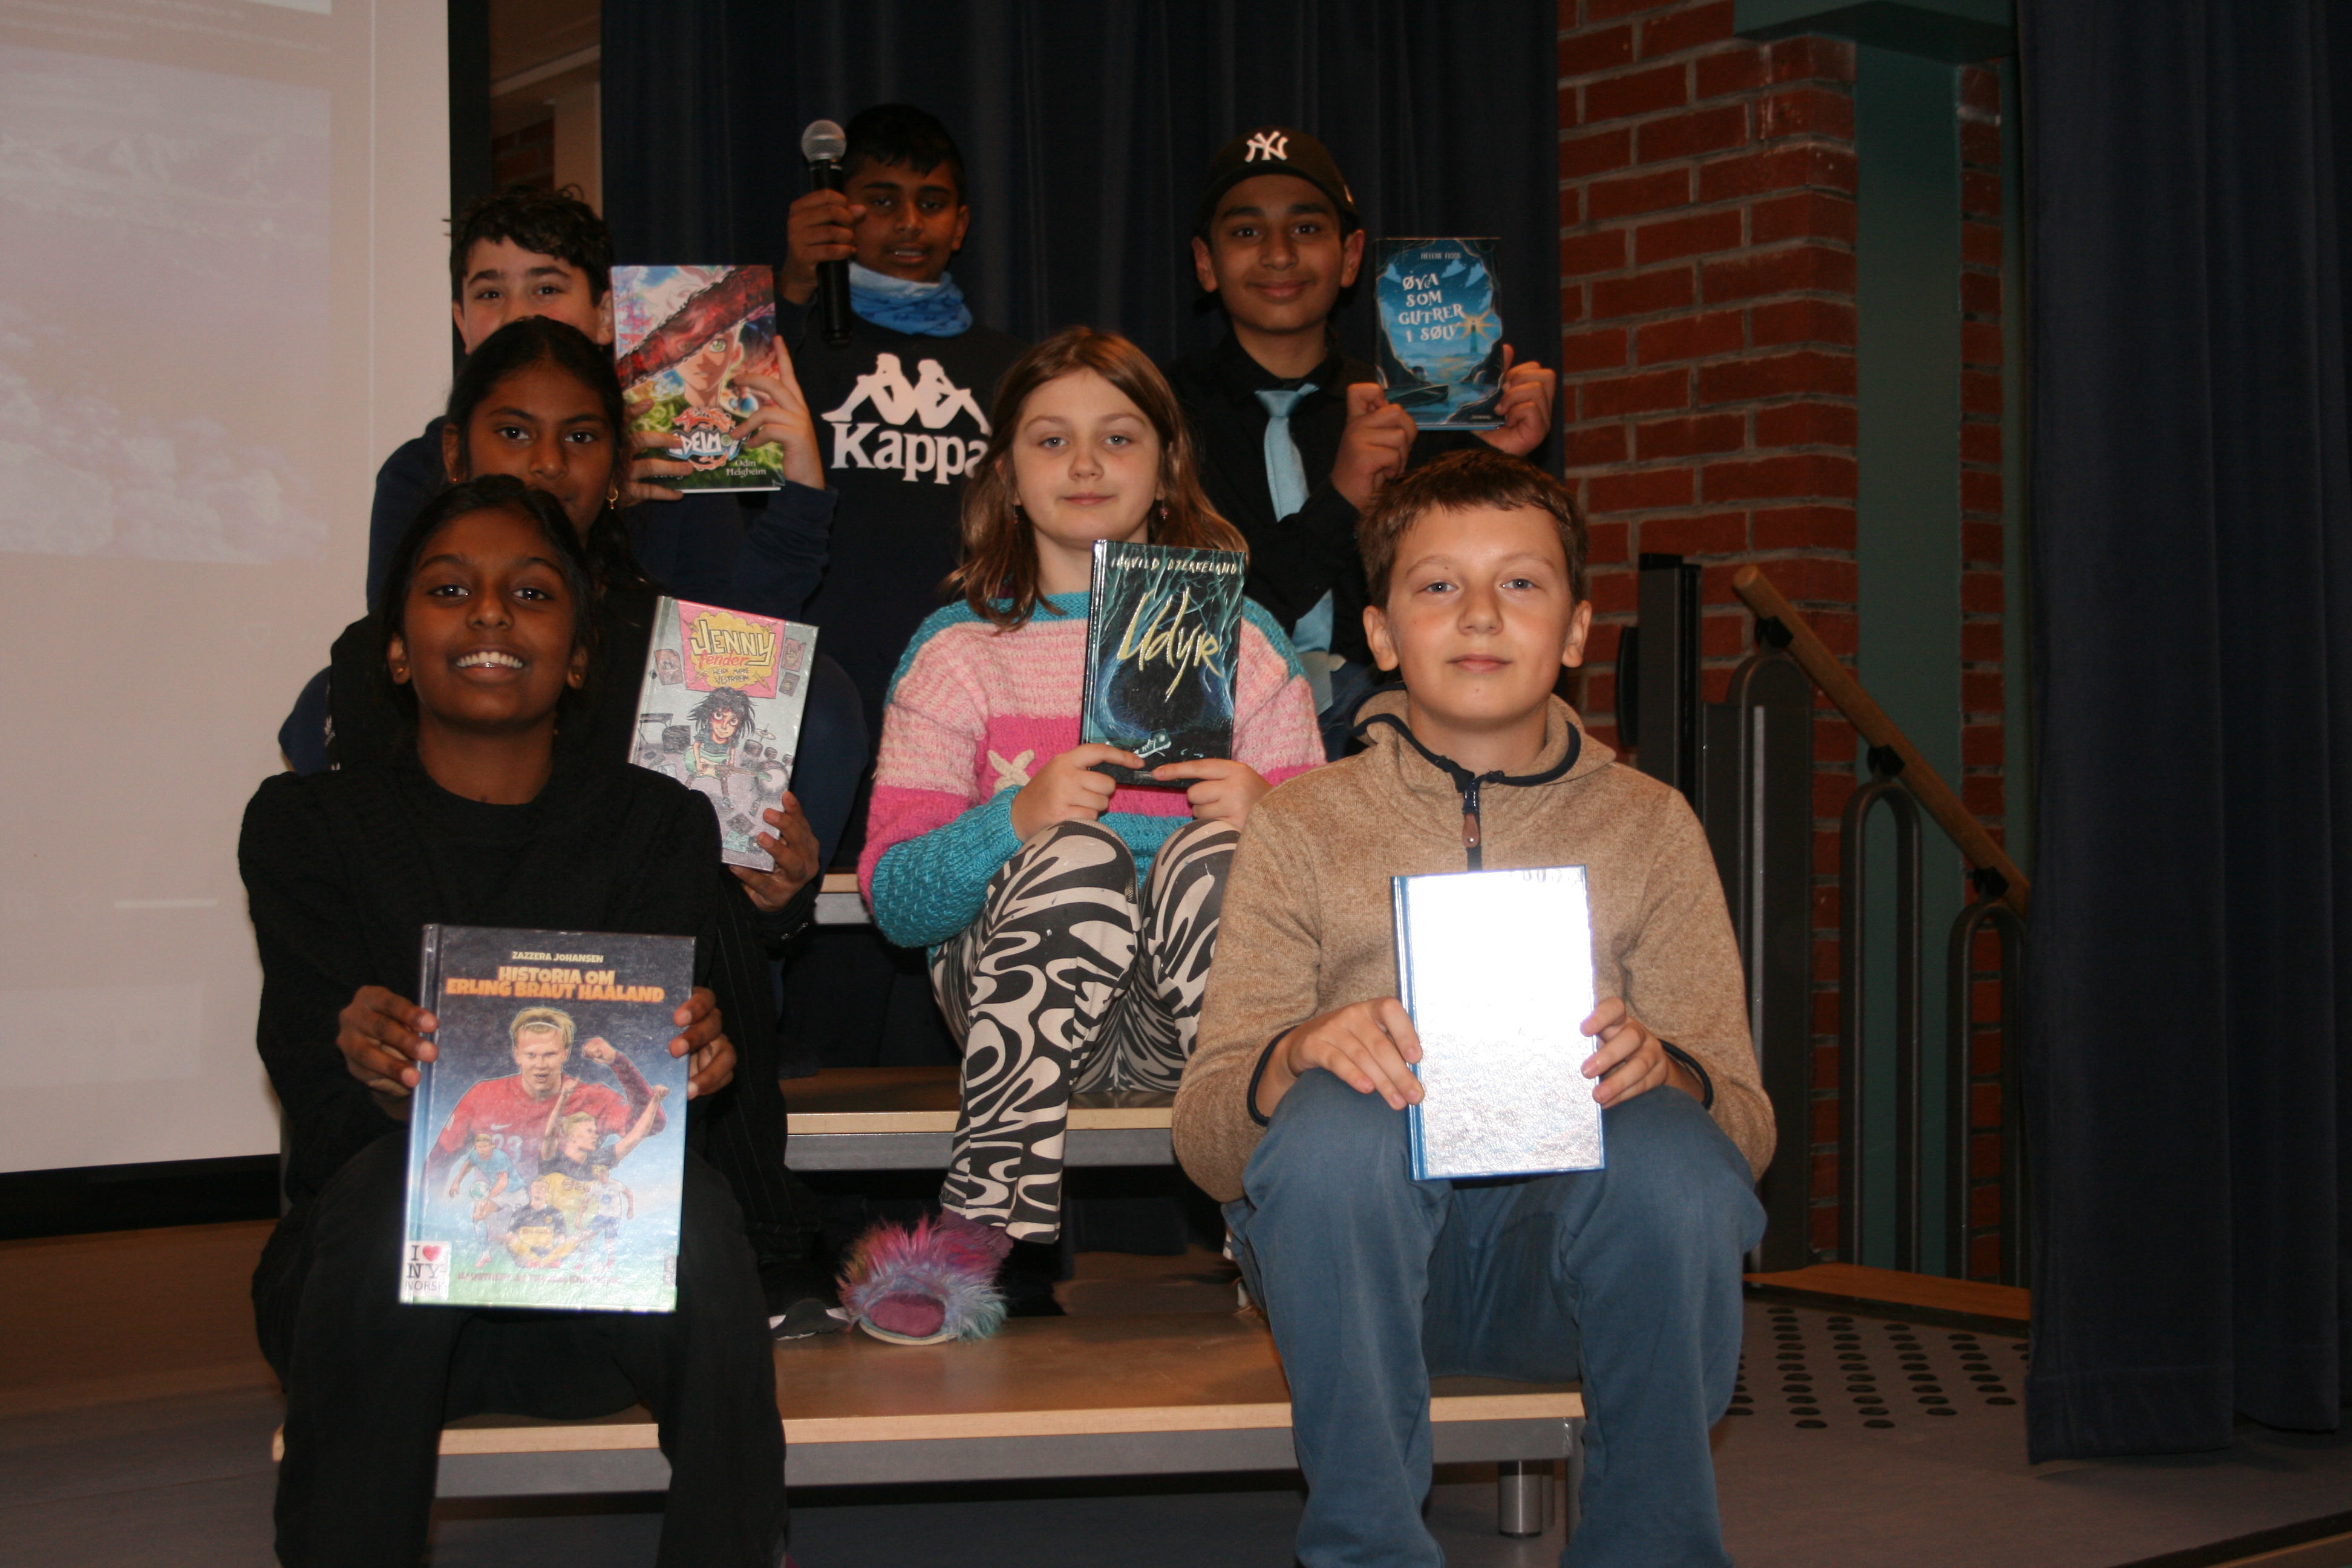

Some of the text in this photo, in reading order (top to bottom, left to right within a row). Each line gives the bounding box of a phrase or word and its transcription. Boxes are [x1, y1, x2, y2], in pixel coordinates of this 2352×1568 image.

[1245, 131, 1289, 163] NY
[1402, 273, 1440, 291] ØYA
[1406, 290, 1443, 307] SOM
[1398, 304, 1466, 325] GUTRER
[1406, 322, 1461, 343] I SØLV
[734, 459, 756, 468] Odin
[831, 422, 988, 485] Kappa
[727, 468, 767, 478] Helgheim
[689, 619, 776, 666] JENNY
[698, 649, 750, 670] fender
[512, 951, 604, 963] ZAZZERA JOHANSEN
[498, 966, 616, 986] HISTORIA OM
[446, 978, 665, 1003] ERLING BRAUT HAALAND
[411, 1245, 420, 1261] I
